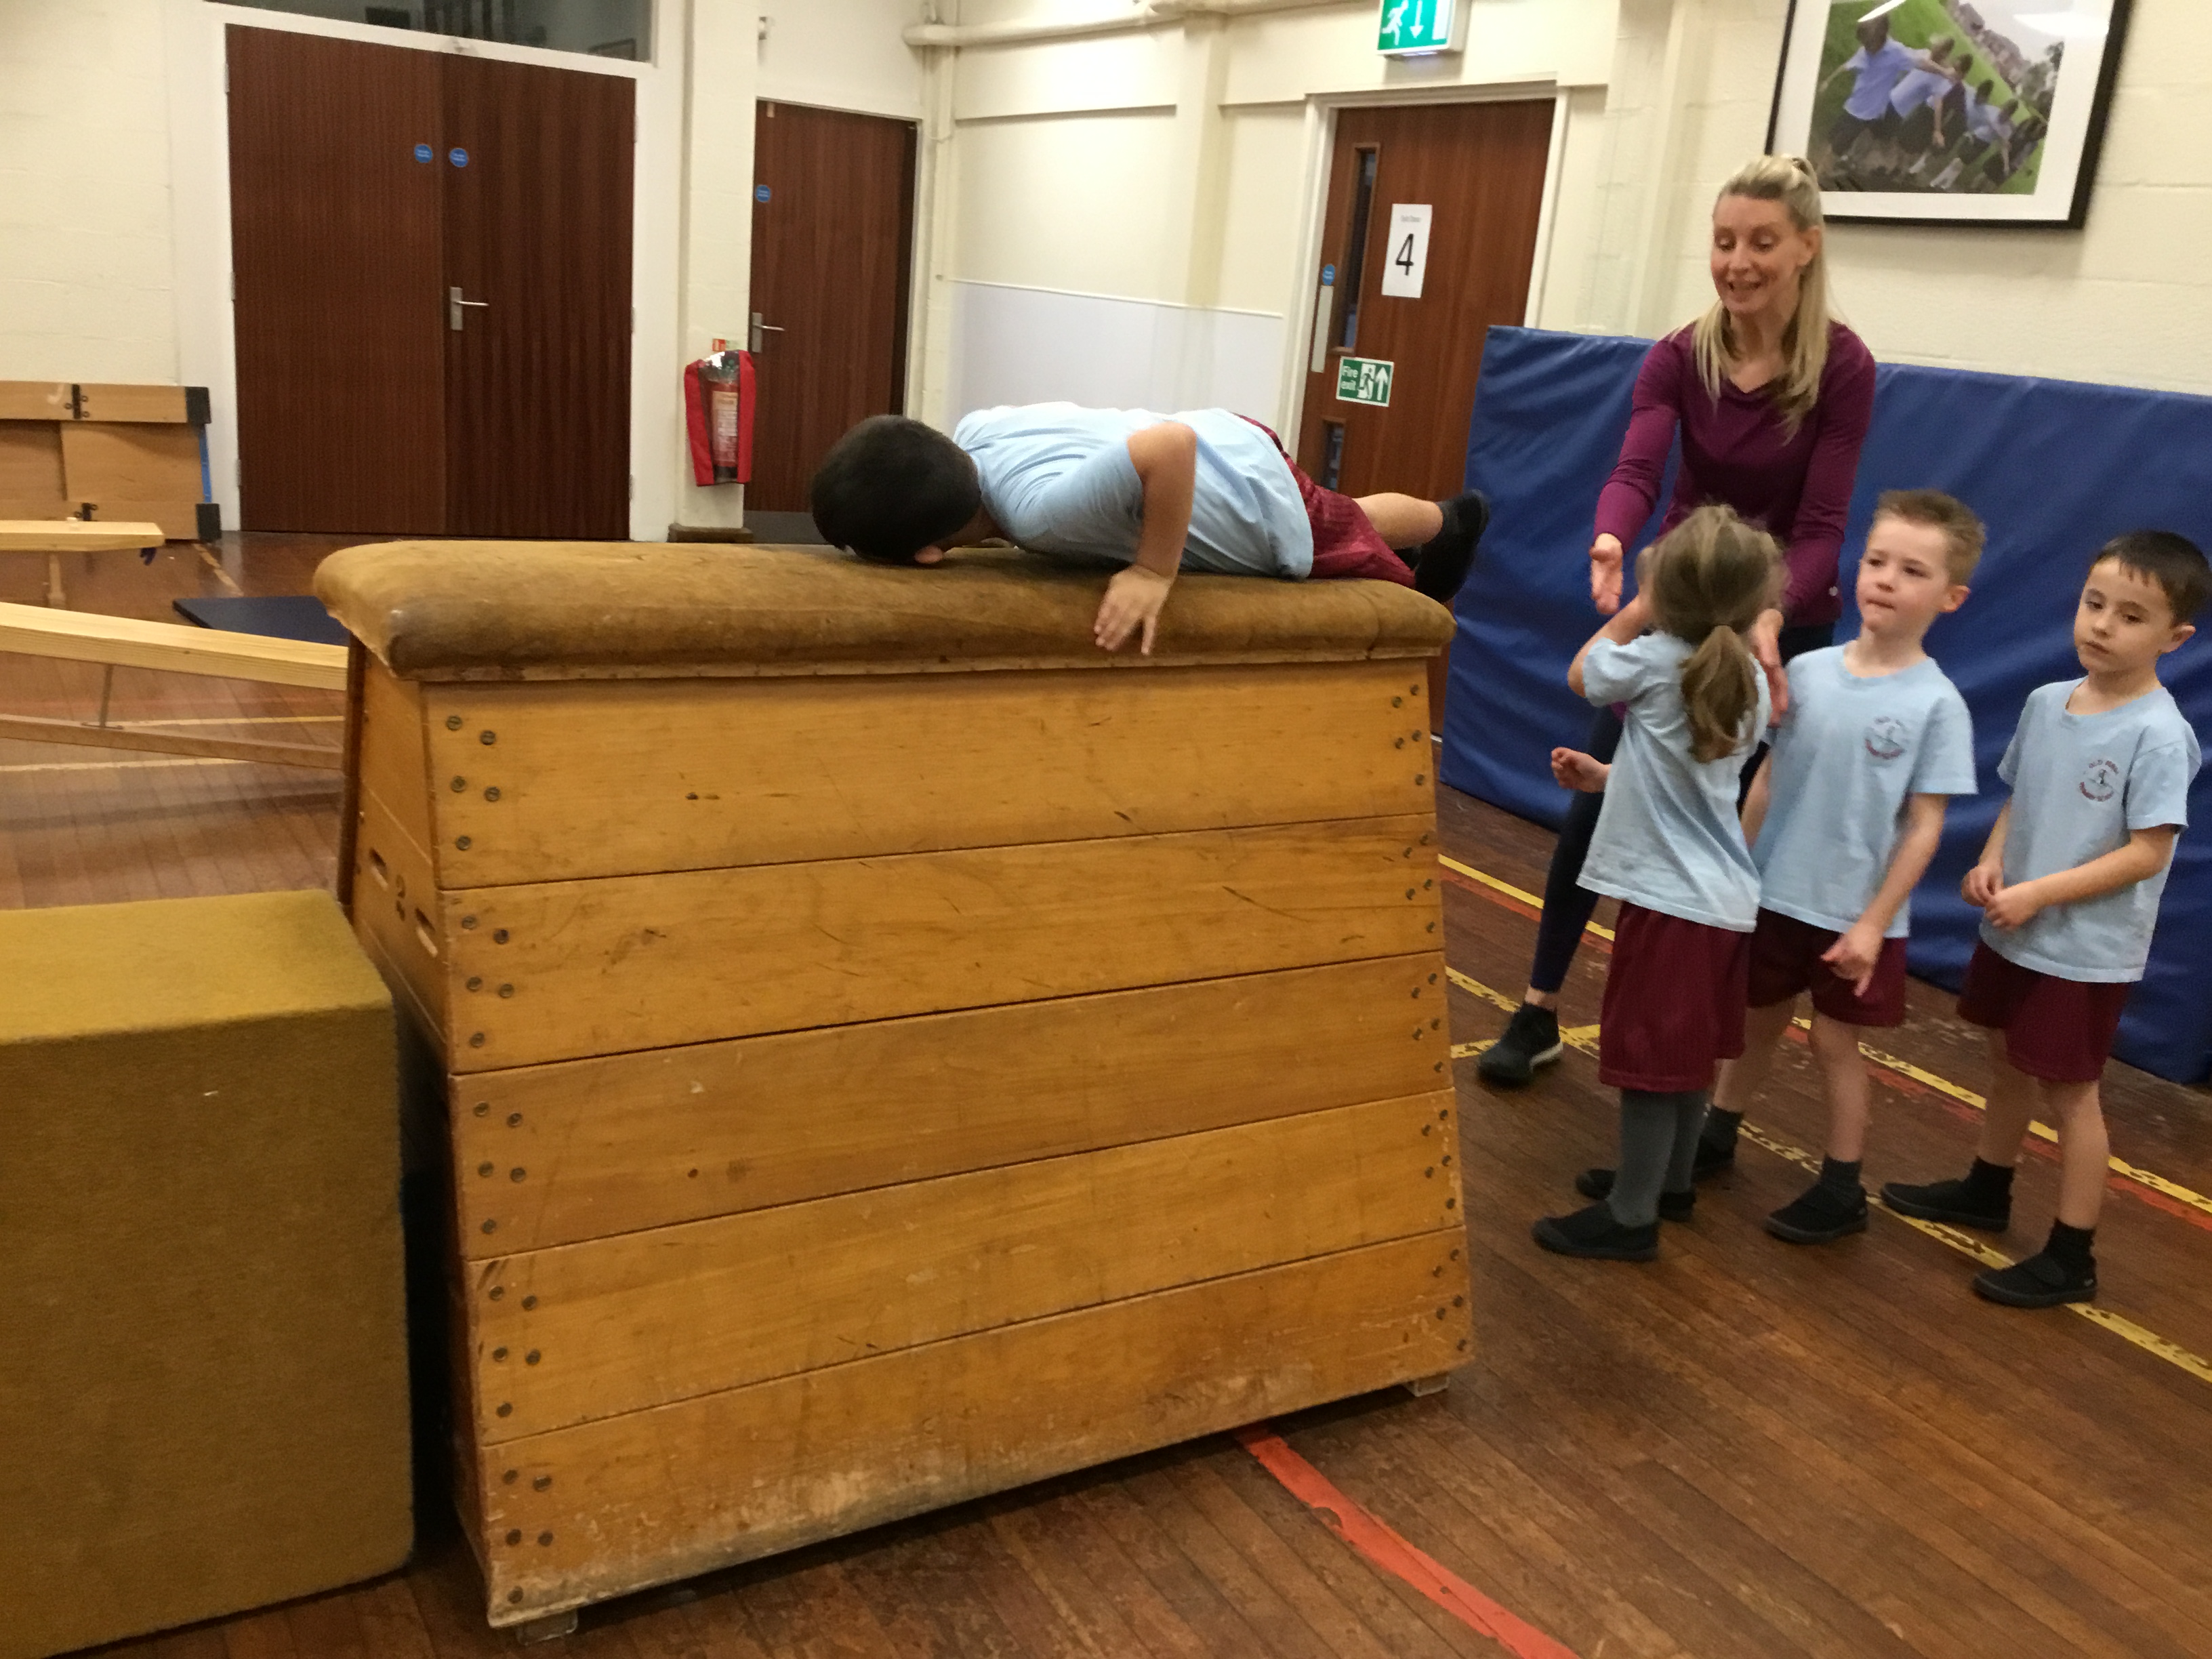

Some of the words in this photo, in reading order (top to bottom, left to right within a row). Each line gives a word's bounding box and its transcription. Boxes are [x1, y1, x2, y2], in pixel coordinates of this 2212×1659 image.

[1395, 233, 1414, 276] 4
[1342, 365, 1359, 378] Fire
[1340, 380, 1357, 391] exit
